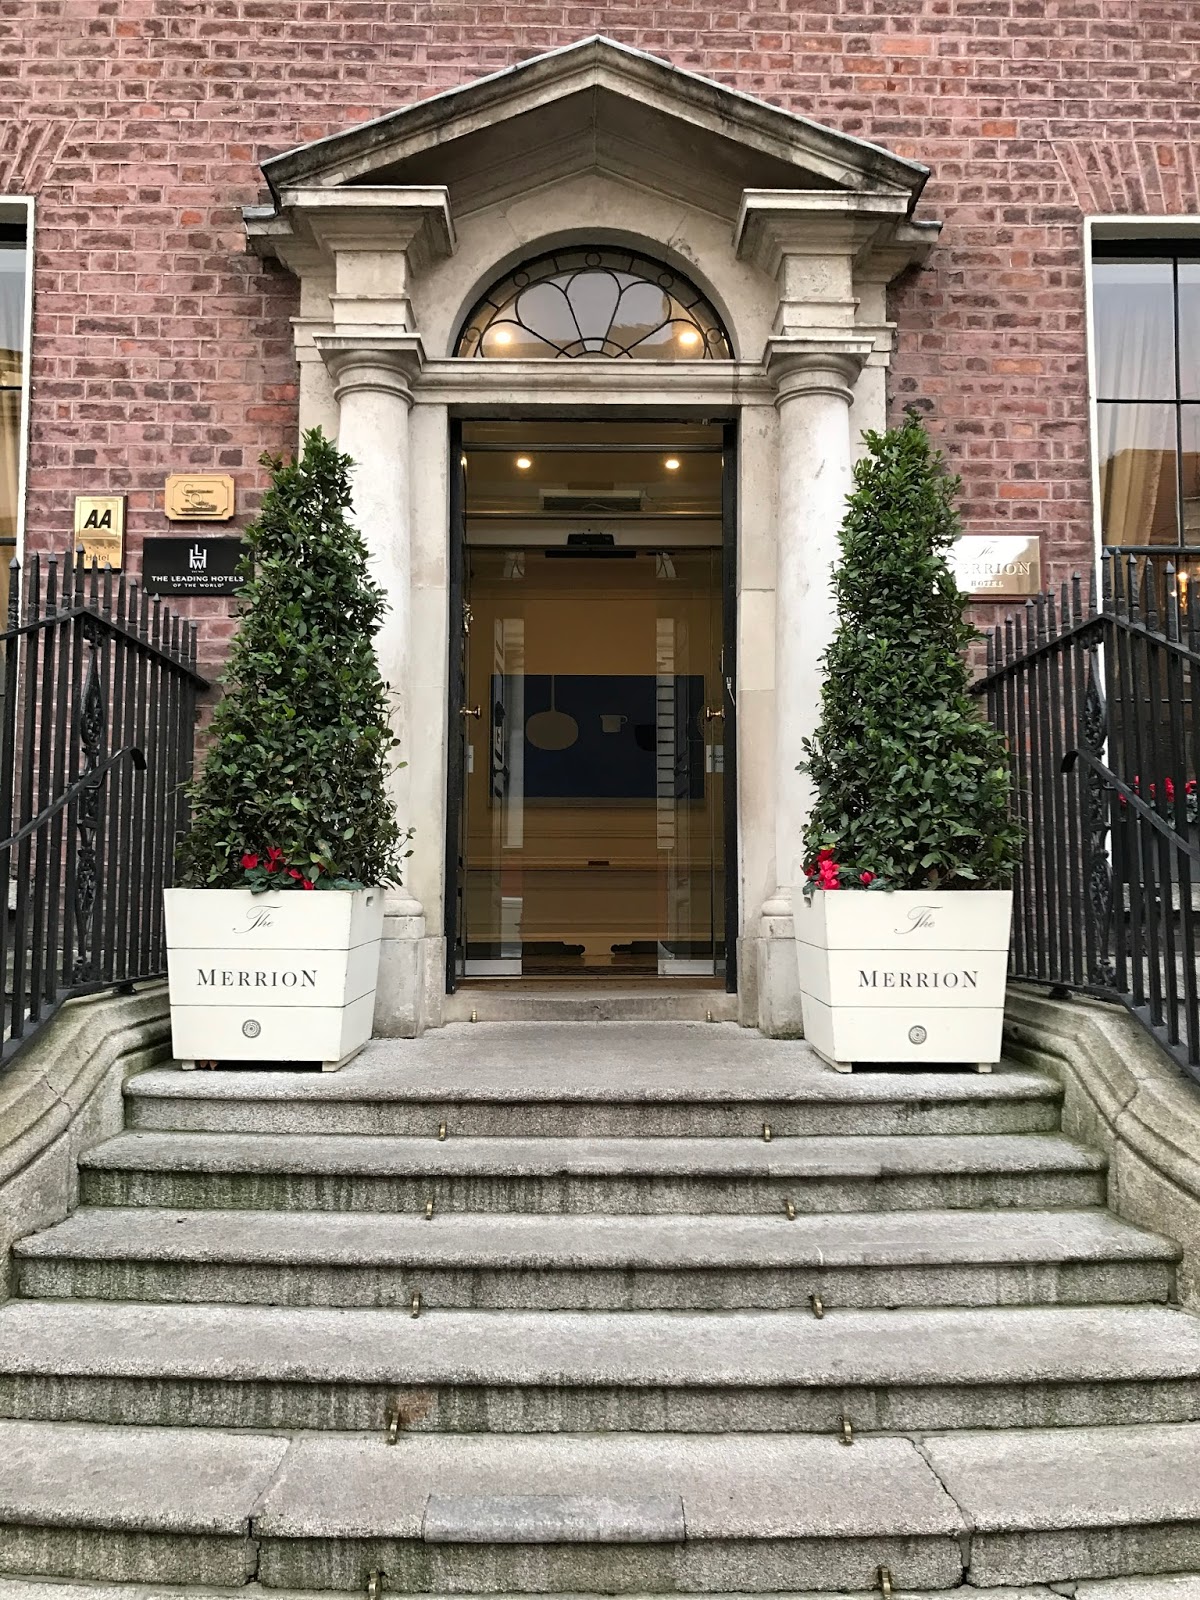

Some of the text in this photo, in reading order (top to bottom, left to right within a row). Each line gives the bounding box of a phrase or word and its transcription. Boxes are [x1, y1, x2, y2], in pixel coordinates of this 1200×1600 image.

[83, 509, 112, 529] AA
[946, 561, 1031, 576] ERRION
[970, 580, 1004, 588] HOTEL
[232, 905, 283, 934] The
[893, 905, 943, 935] The
[196, 968, 318, 988] MERRION
[858, 970, 979, 989] MERRION
